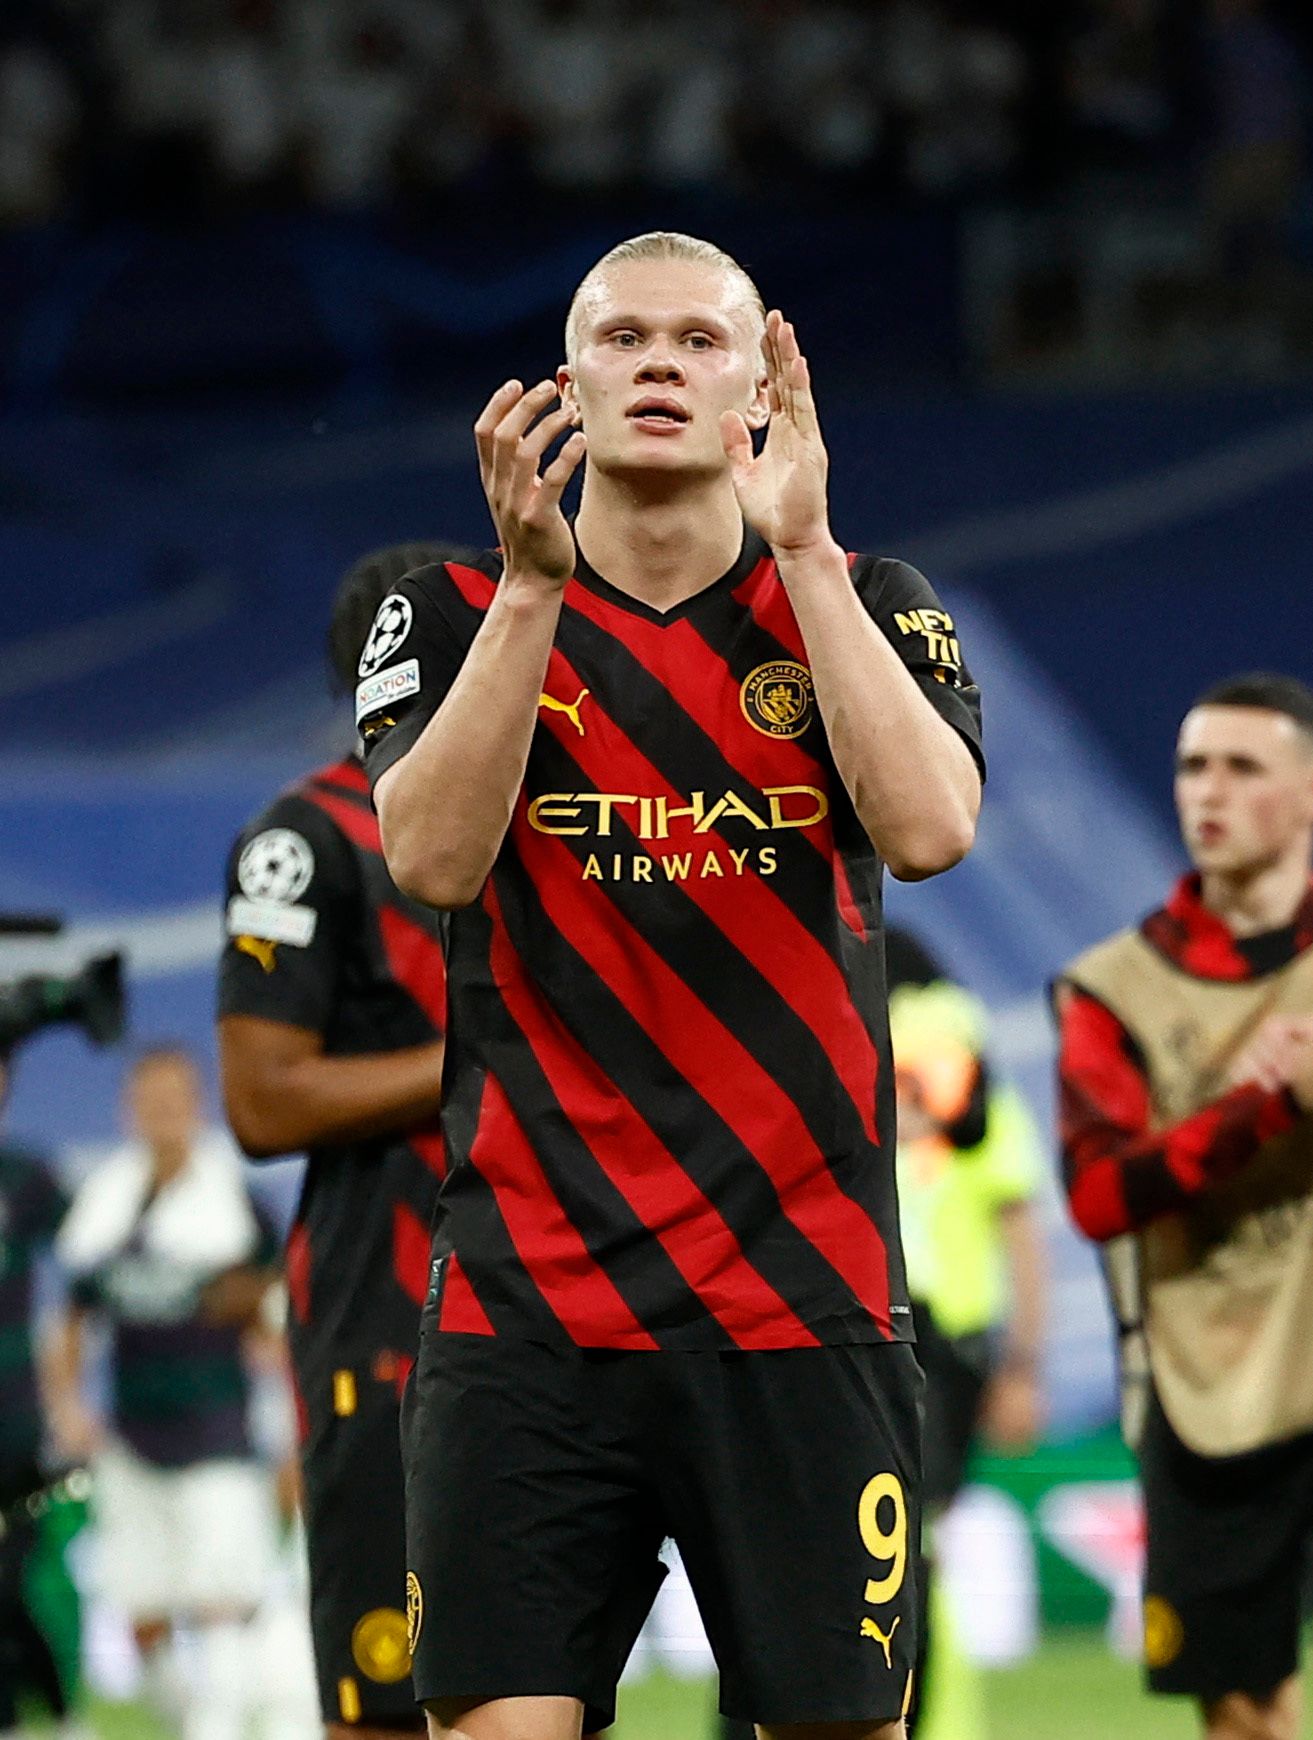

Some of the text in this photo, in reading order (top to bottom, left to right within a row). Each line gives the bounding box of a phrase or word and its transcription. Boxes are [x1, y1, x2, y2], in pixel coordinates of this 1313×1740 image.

[749, 667, 811, 691] MANCHESTER
[770, 725, 793, 733] CITY
[527, 785, 829, 839] ETIHAD
[581, 847, 778, 882] AIRWAYS
[858, 1472, 907, 1604] 9
